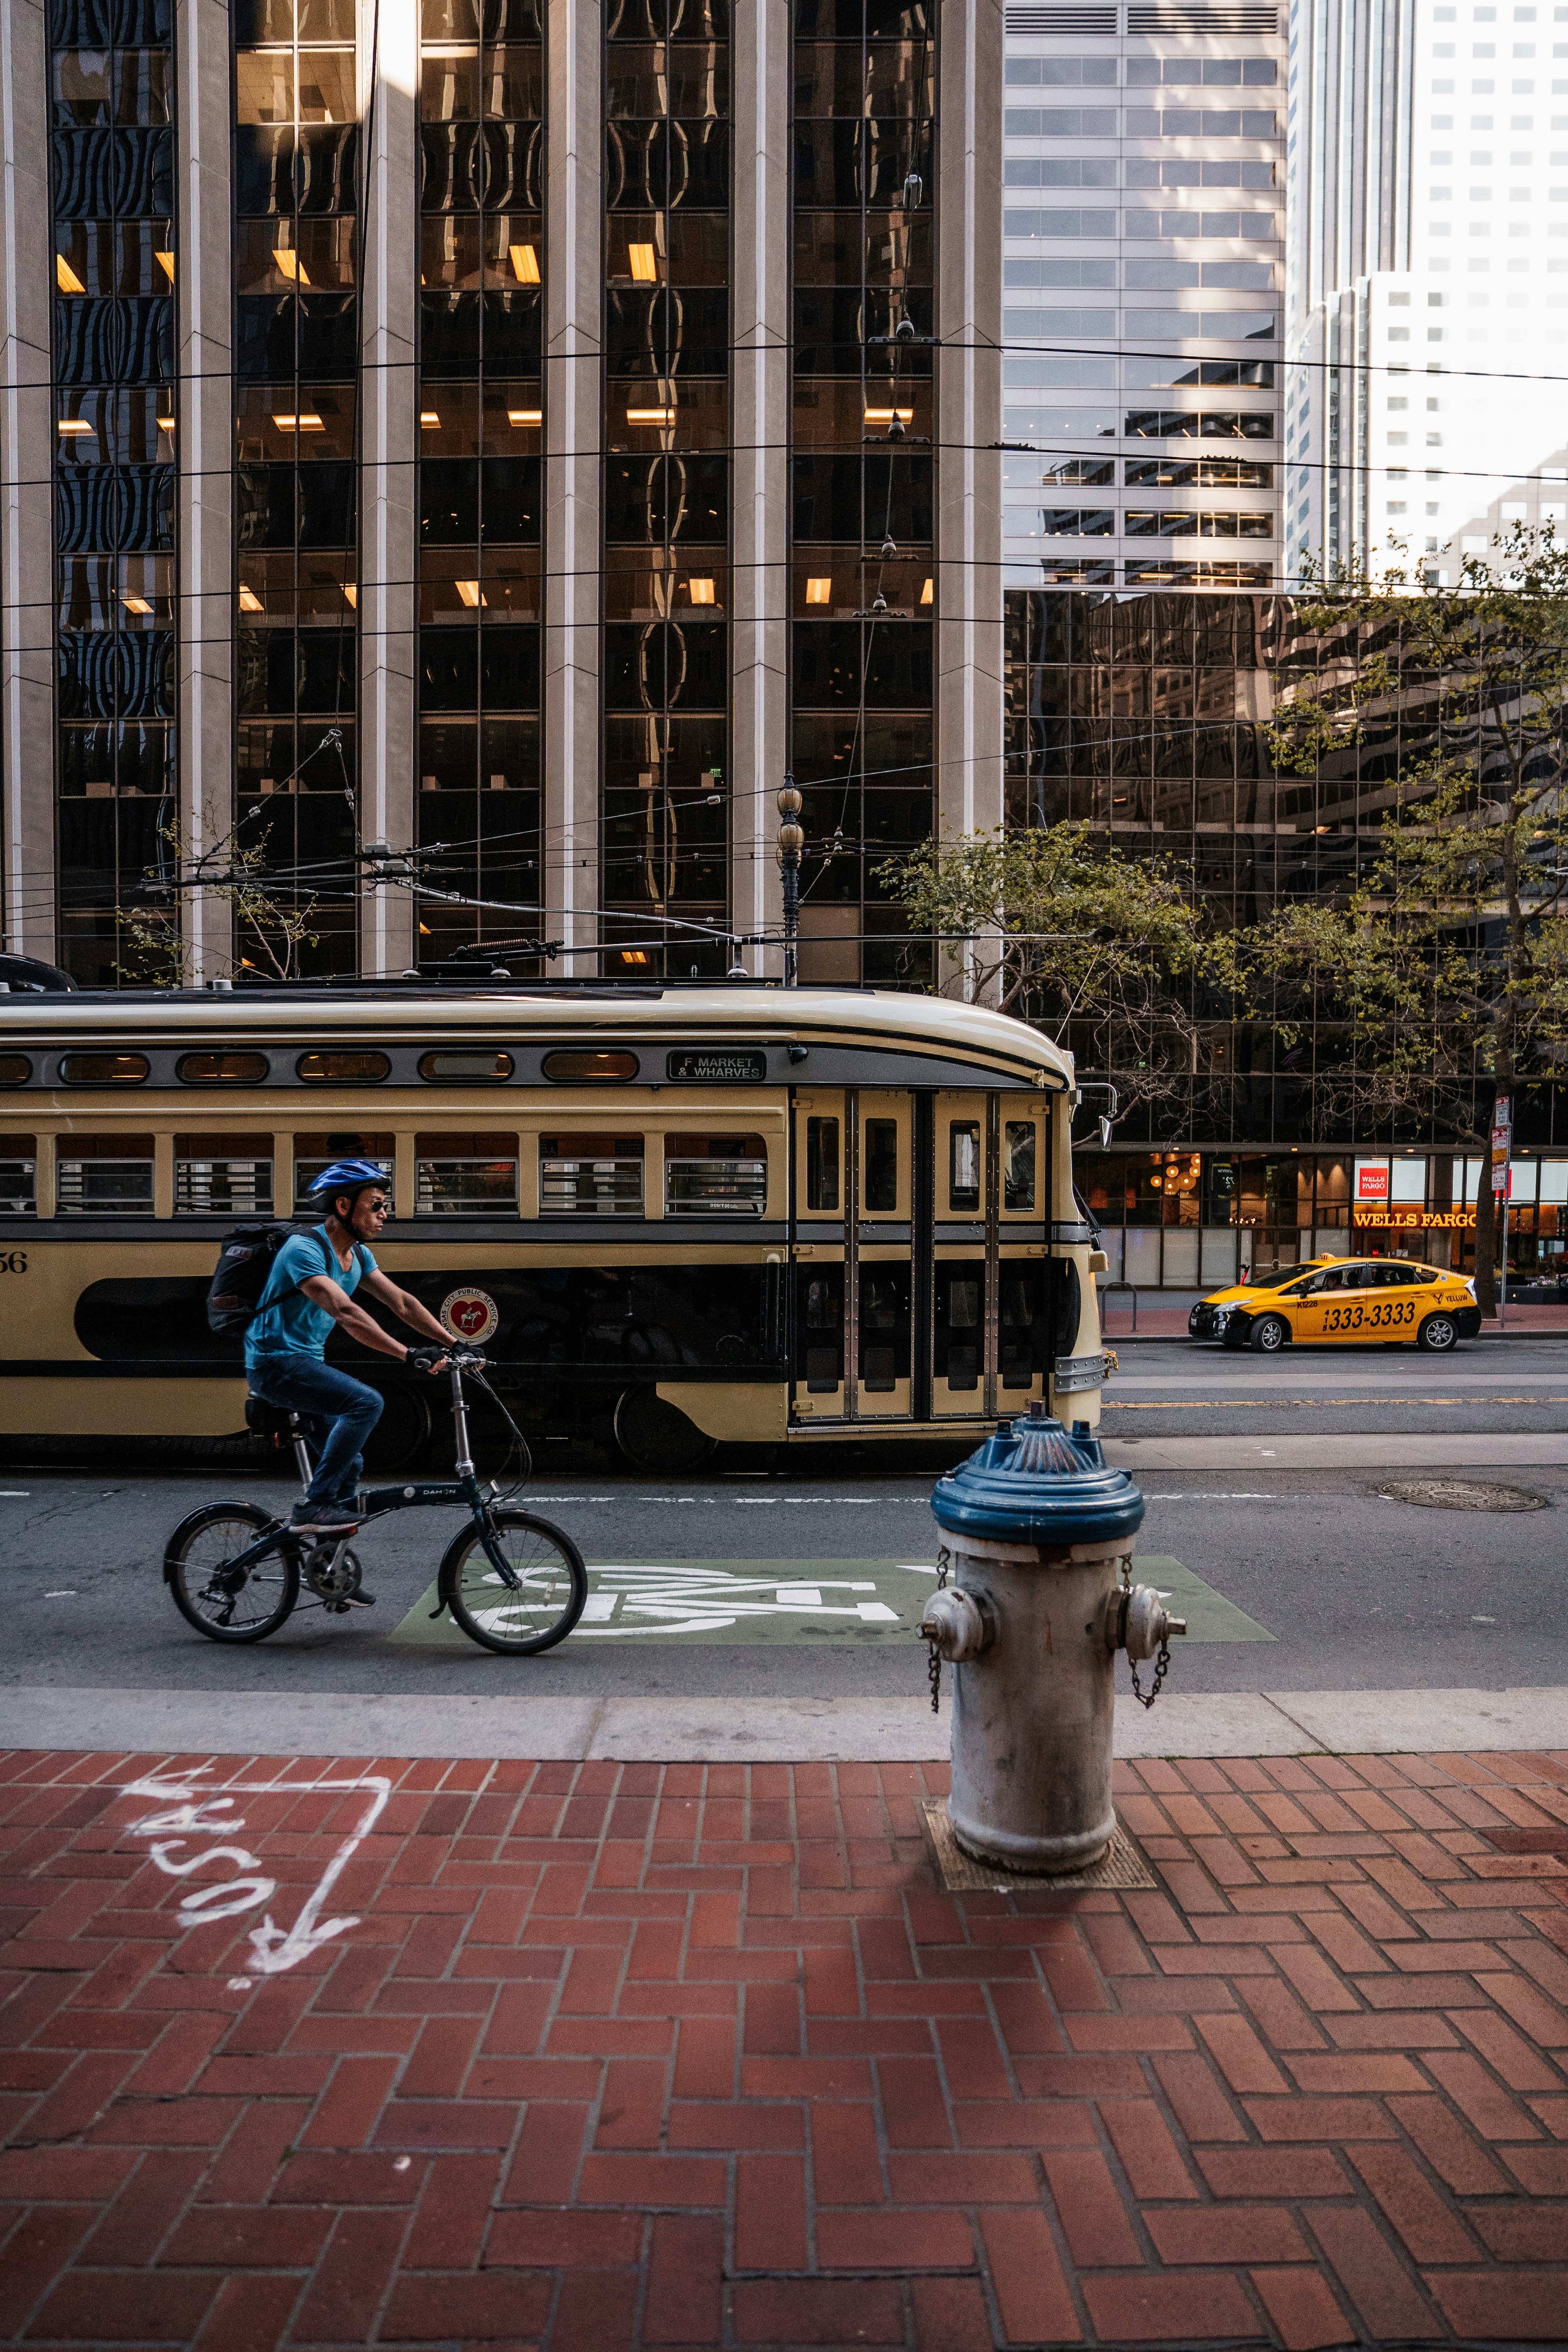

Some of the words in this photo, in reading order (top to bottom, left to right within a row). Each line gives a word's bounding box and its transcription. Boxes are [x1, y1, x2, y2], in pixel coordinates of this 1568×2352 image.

[685, 1058, 693, 1066] F
[699, 1058, 753, 1067] MARKET
[678, 1067, 687, 1076] &
[694, 1068, 760, 1077] WHARVES
[1354, 1213, 1417, 1227] WELLS
[444, 1294, 455, 1307] CITY
[1297, 1300, 1318, 1308] K1228
[484, 1296, 498, 1323] SERVICE
[1329, 1301, 1415, 1331] 333-3333
[486, 1326, 495, 1334] CO.
